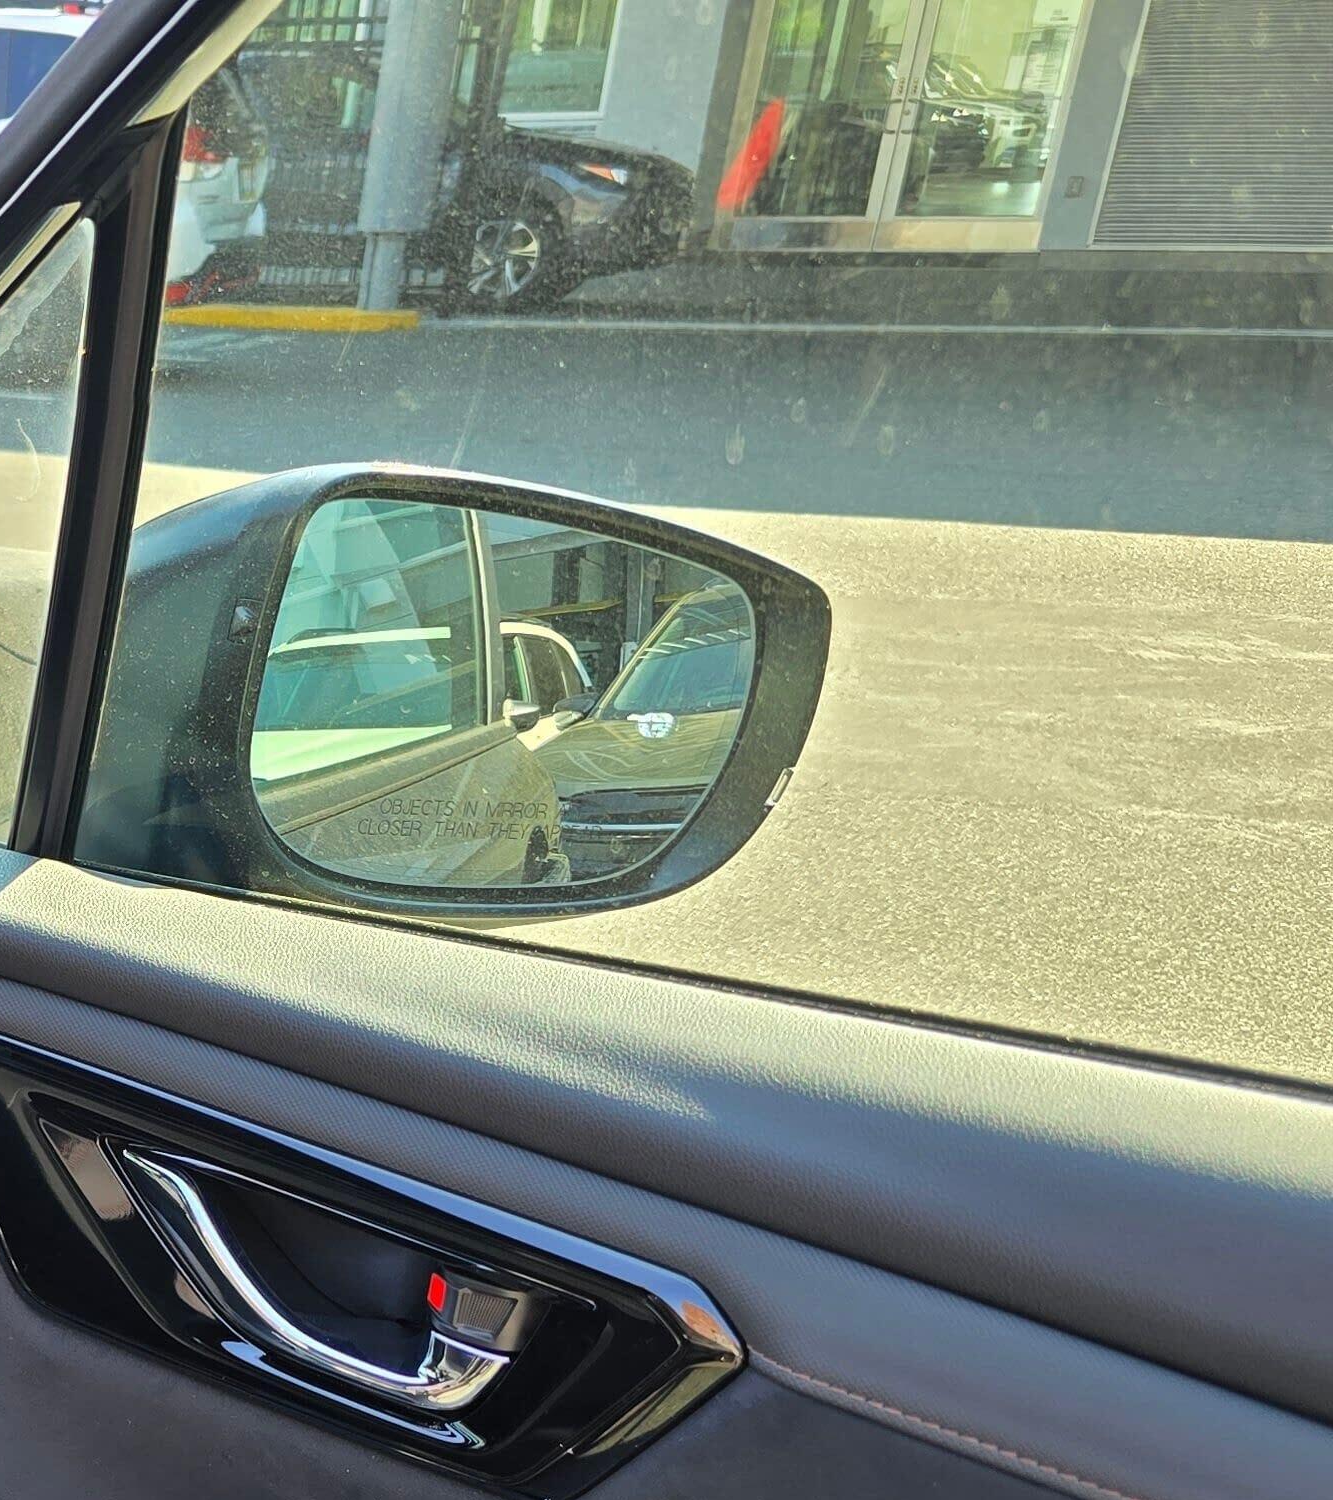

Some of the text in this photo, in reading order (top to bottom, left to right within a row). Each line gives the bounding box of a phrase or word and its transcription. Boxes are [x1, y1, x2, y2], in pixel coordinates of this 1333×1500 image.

[379, 798, 454, 817] OBJECTS
[462, 801, 477, 817] IN
[357, 818, 423, 837] CLOSER
[436, 821, 479, 839] THAN
[489, 822, 530, 840] THEY
